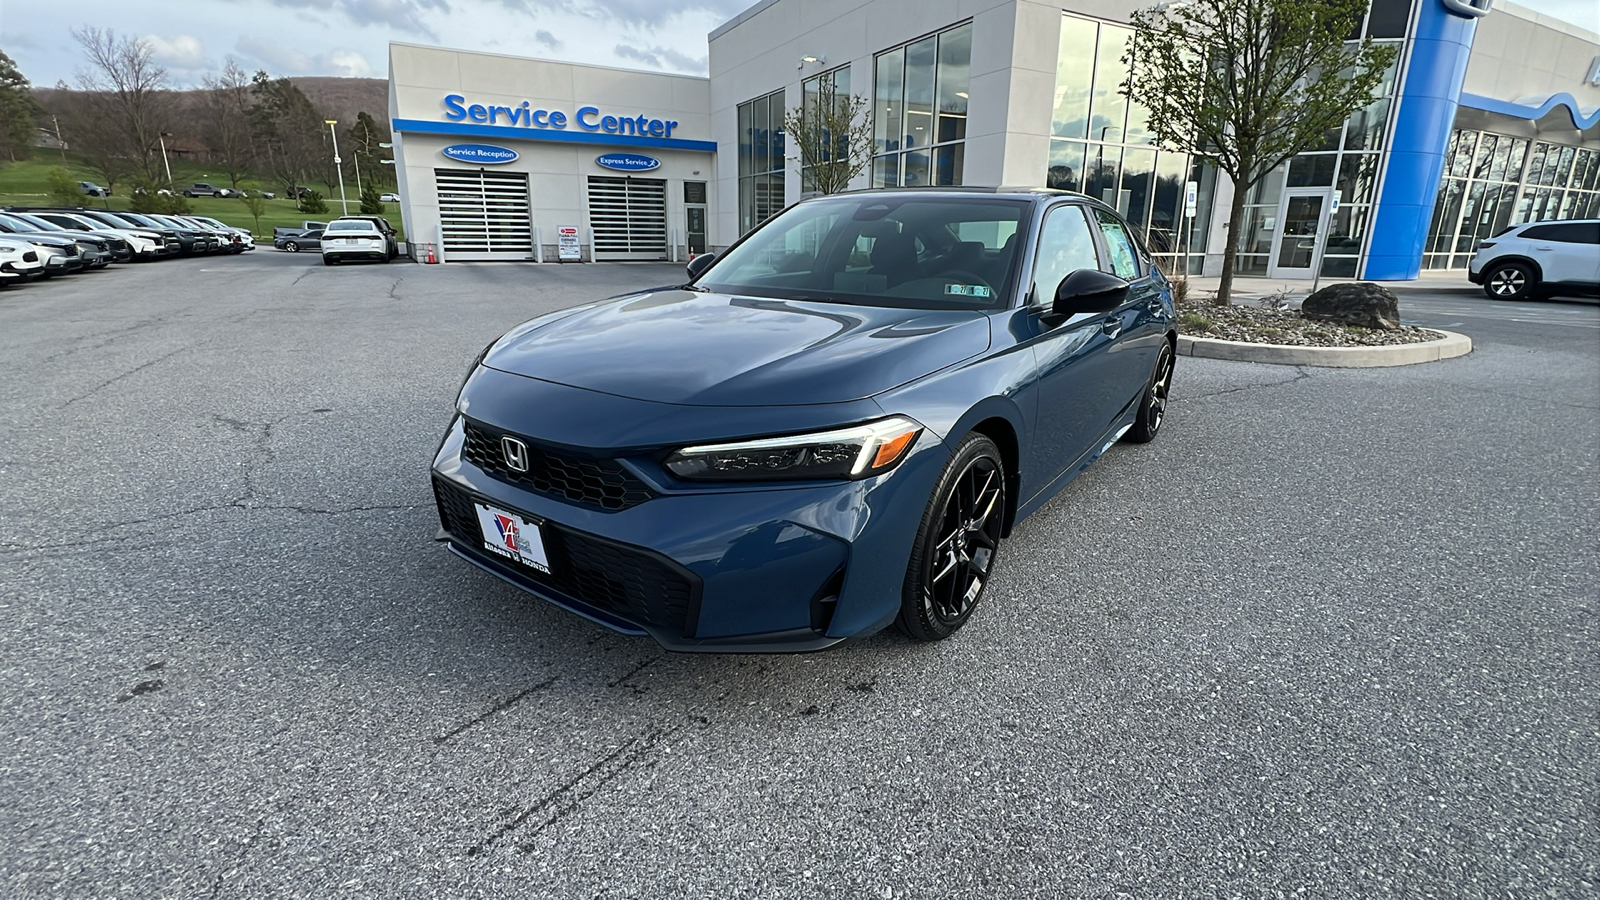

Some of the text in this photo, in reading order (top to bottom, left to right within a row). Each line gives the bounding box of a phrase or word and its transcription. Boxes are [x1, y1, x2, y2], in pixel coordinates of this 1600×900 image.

[445, 94, 678, 138] Service Center
[447, 148, 514, 159] Service Reception
[600, 157, 647, 166] Express Service
[982, 287, 989, 295] 27
[521, 557, 552, 575] HONDA
